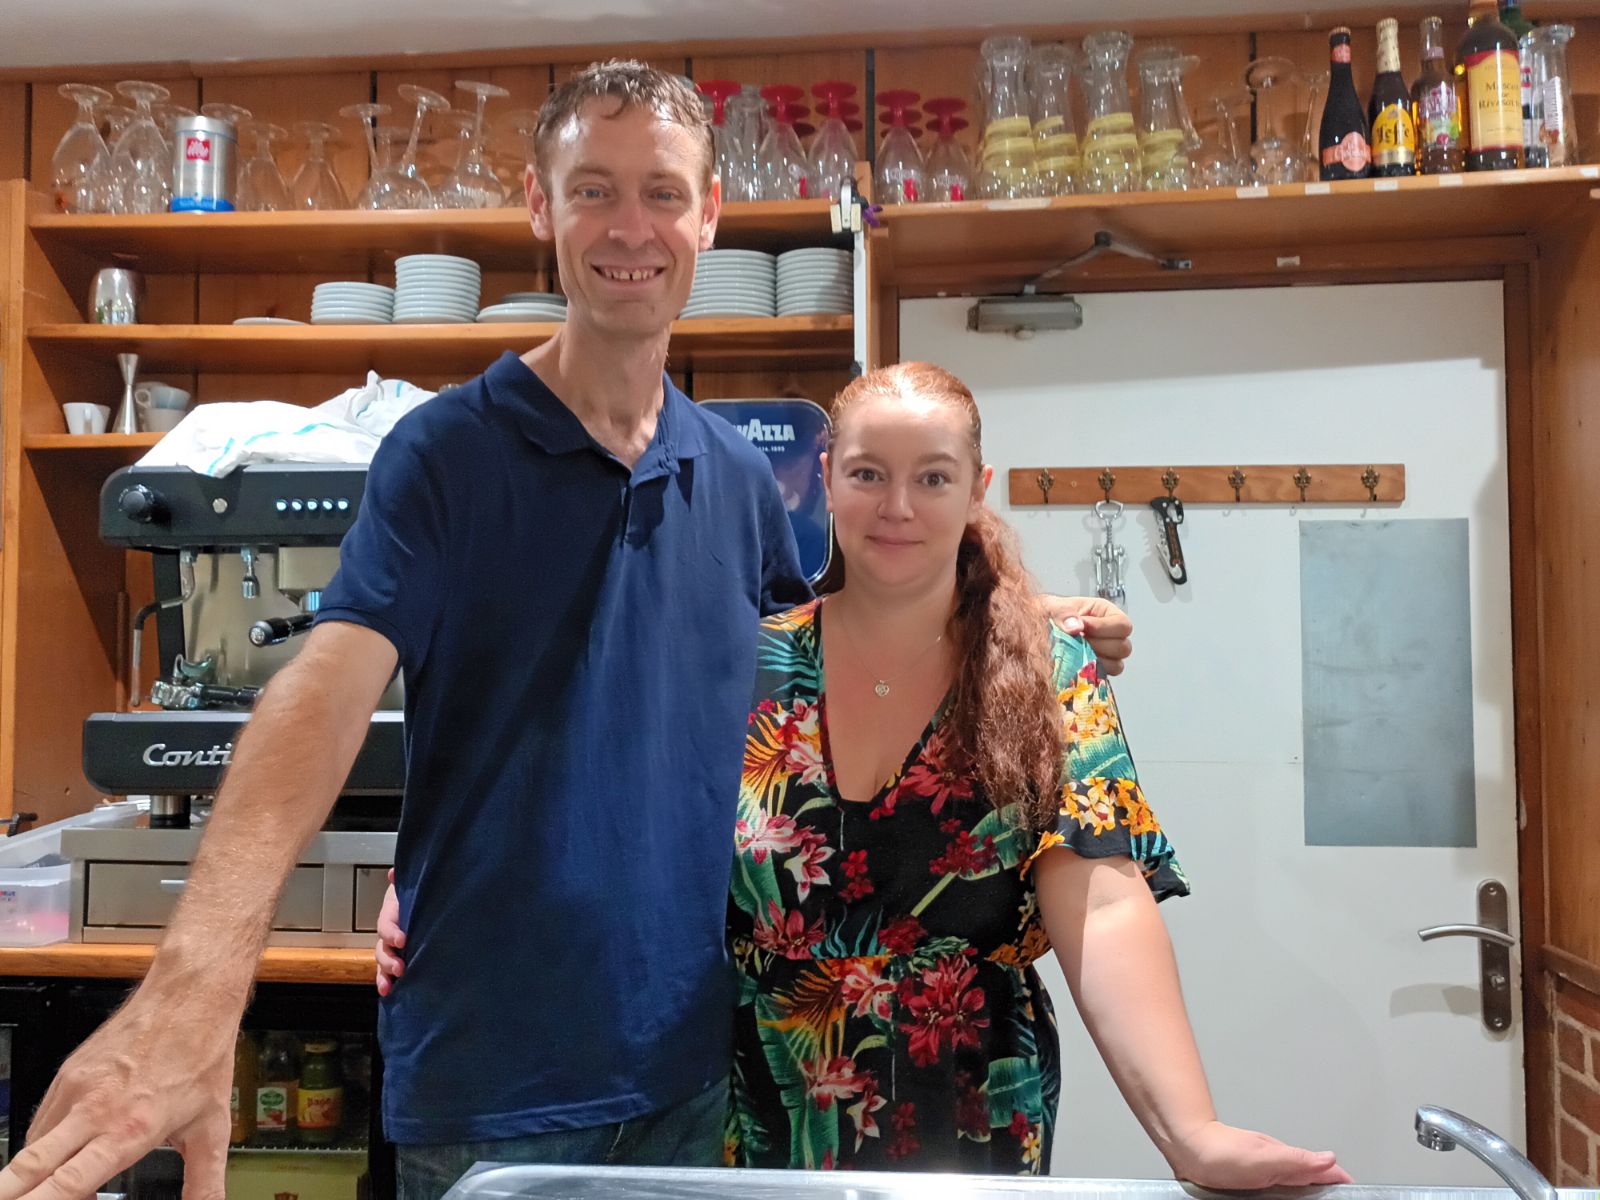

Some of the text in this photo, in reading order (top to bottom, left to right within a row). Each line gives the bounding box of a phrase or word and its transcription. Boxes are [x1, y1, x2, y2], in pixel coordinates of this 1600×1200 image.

[187, 140, 210, 158] illy
[733, 418, 796, 441] VAZZA
[142, 742, 233, 766] Conti
